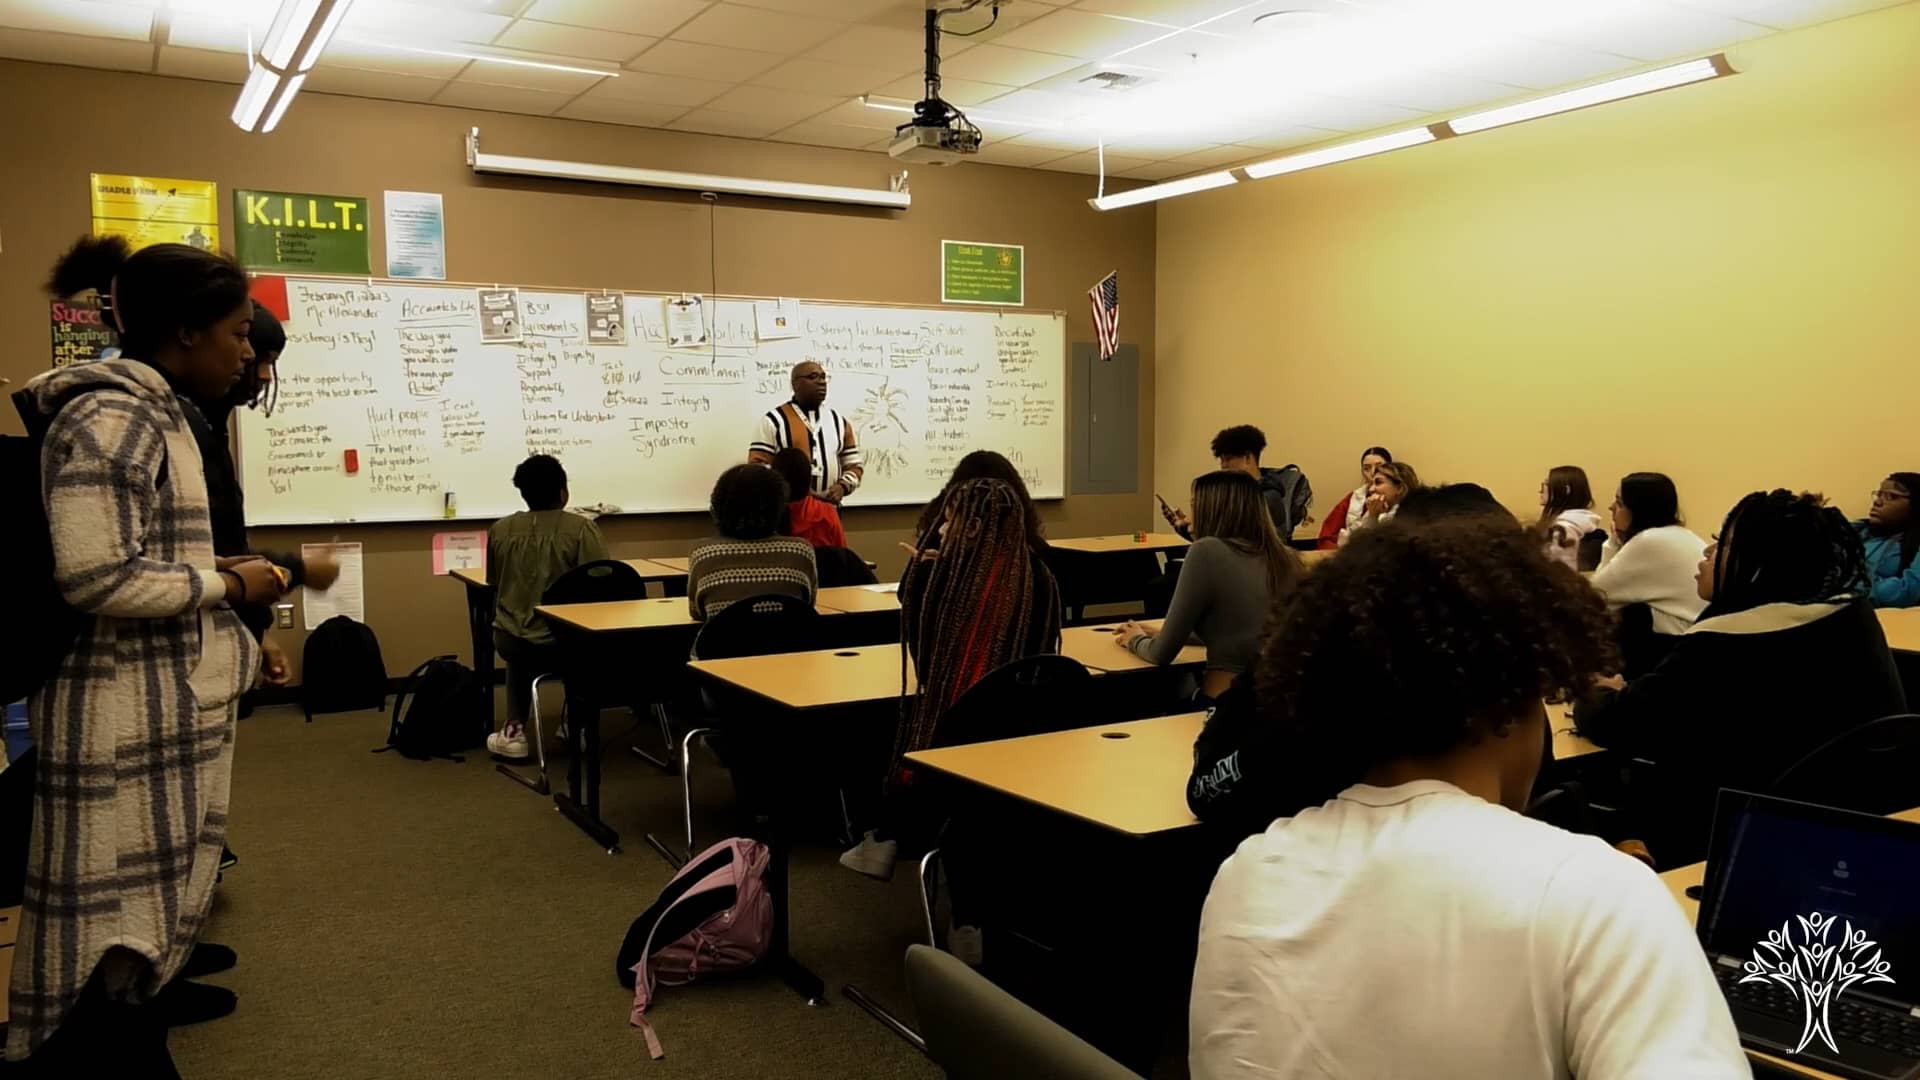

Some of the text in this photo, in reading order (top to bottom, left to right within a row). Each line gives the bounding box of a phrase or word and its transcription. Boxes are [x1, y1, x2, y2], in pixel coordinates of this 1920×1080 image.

[246, 195, 363, 231] K.I.L.T.
[53, 326, 111, 346] hanging
[55, 342, 95, 355] after
[659, 356, 747, 379] Commitment
[661, 391, 711, 412] Integrity
[366, 406, 394, 424] Hurt
[628, 417, 689, 433] Imposter
[632, 434, 697, 459] Syndrome
